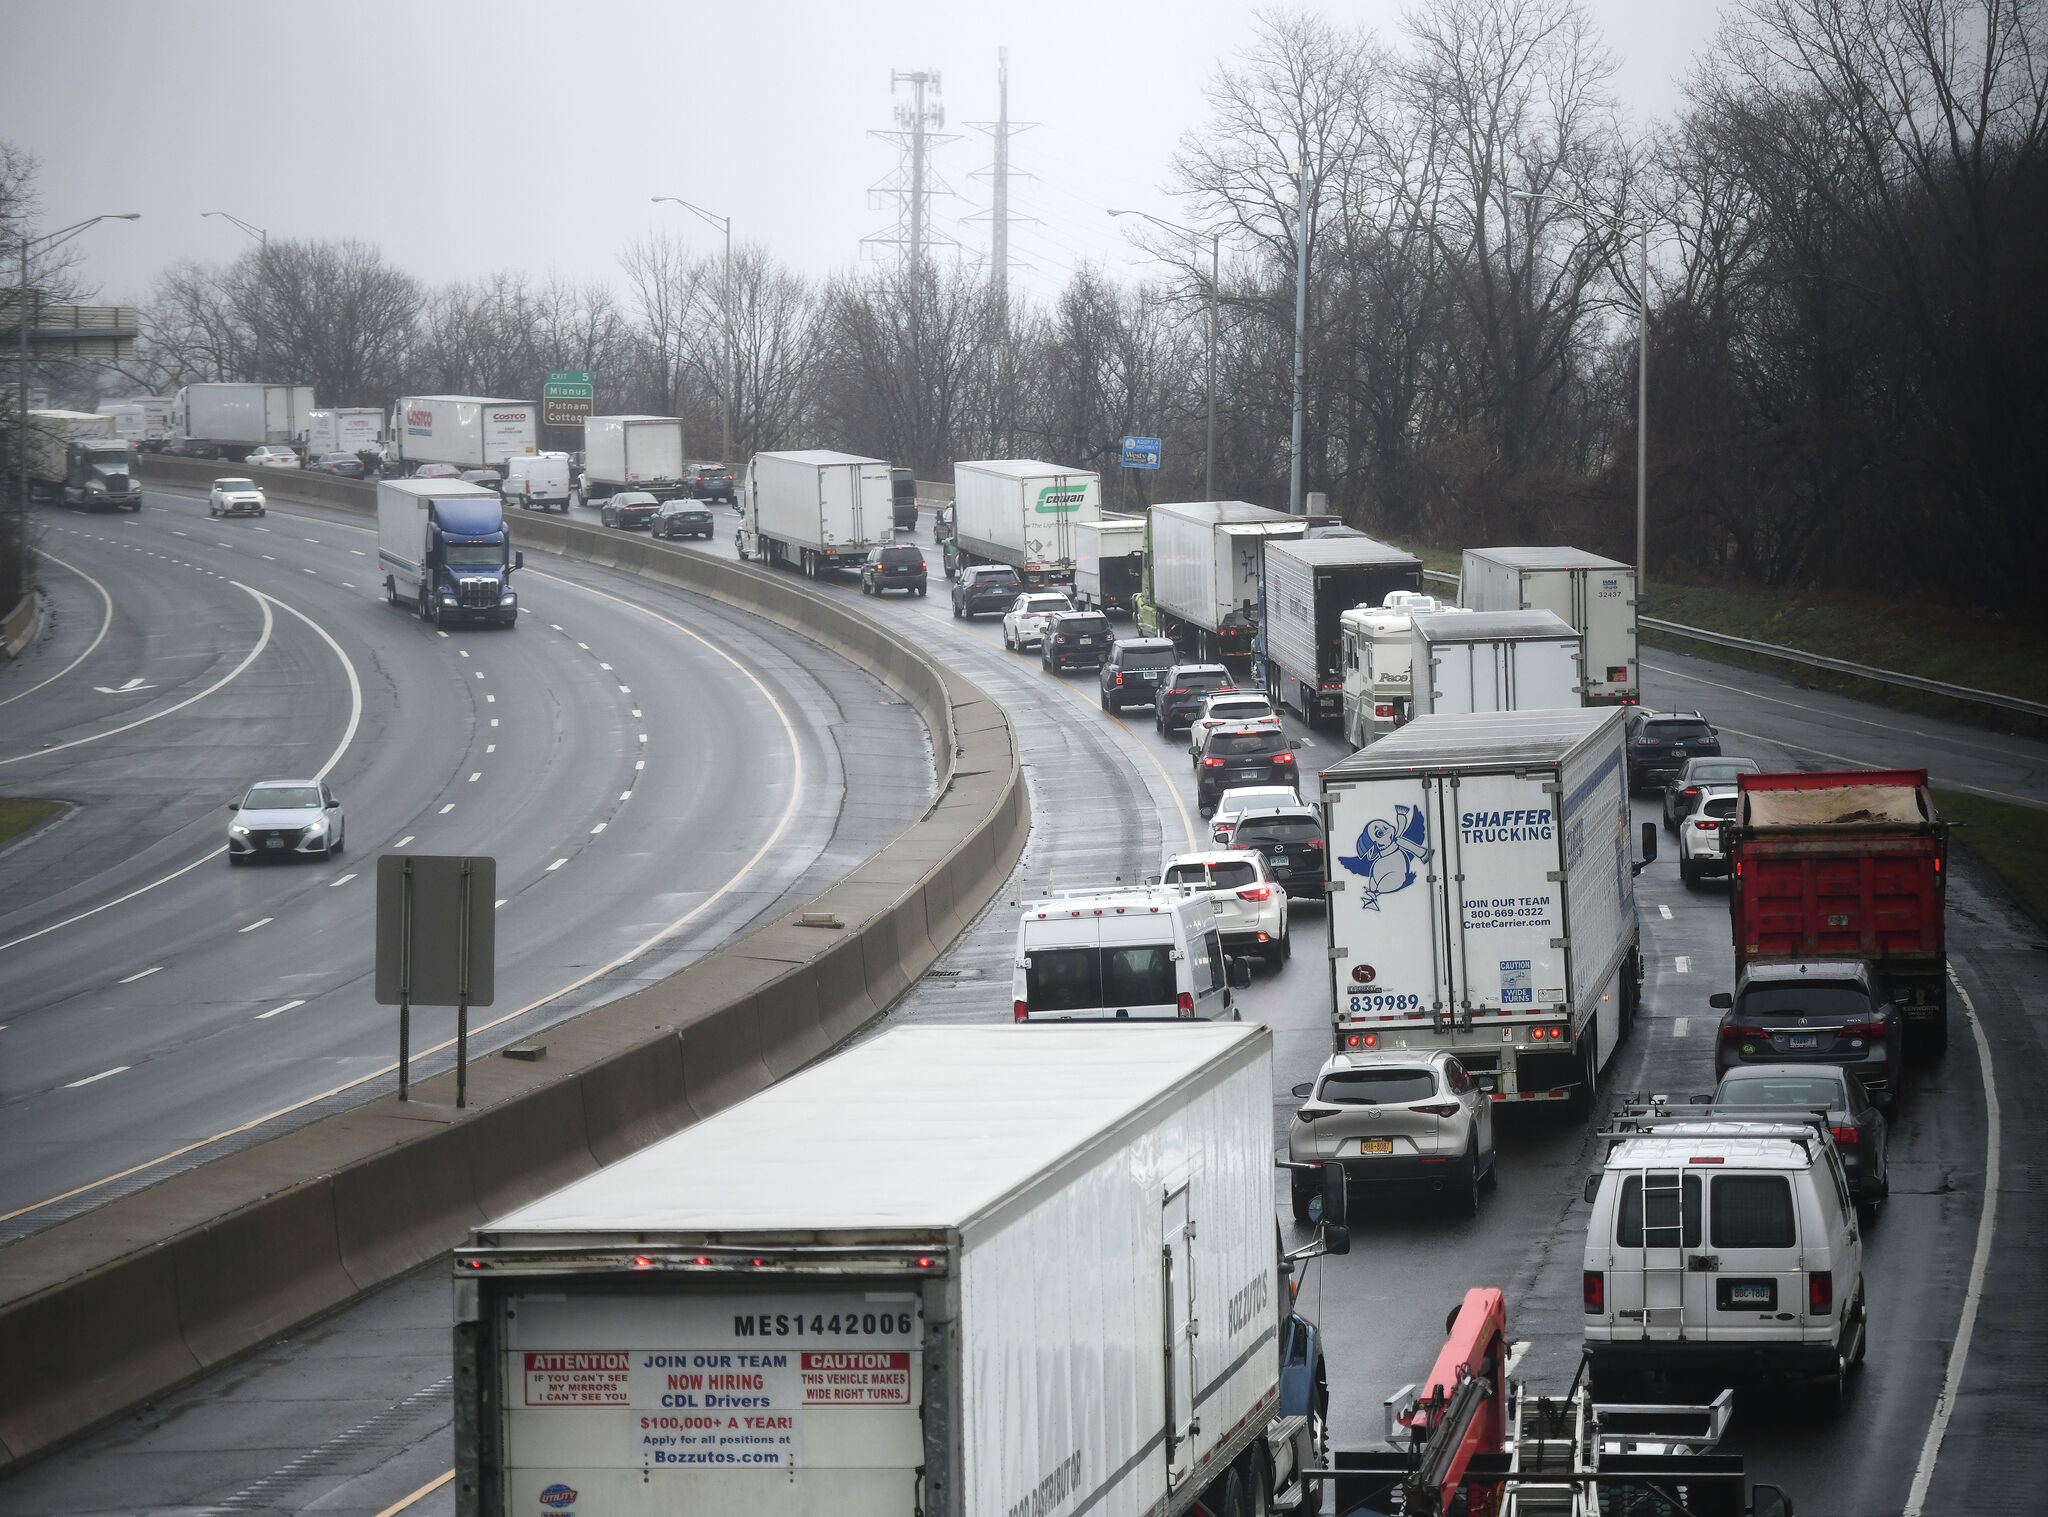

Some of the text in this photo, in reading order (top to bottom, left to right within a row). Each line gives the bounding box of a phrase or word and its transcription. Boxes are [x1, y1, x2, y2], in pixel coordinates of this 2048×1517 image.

[582, 373, 589, 381] 5
[550, 387, 587, 395] Mianus
[548, 402, 589, 410] Putnam
[548, 413, 586, 423] Cottag
[1379, 672, 1408, 682] Pace
[1461, 809, 1551, 828] SHAFFER
[1461, 826, 1552, 843] TRUCKING
[1463, 897, 1550, 908] JOIN OUR TEAM
[1471, 908, 1544, 918] 800-669-0322
[1463, 919, 1551, 929] CreteCarrier.com
[1500, 961, 1530, 970] CAUTION
[1350, 994, 1419, 1012] 839989
[735, 1313, 912, 1336] MES1442006
[534, 1354, 629, 1369] ATTENTION
[644, 1356, 787, 1368] JOIN OUR TEAM
[810, 1354, 891, 1369] CAUTION
[573, 1374, 604, 1382] CAN'T
[668, 1374, 764, 1390] NOW HIRING
[802, 1374, 906, 1384] THIS VEHICLE MAKES
[547, 1393, 578, 1401] CAN'T
[806, 1389, 903, 1399] WIDE RIGHT TURNS.
[661, 1394, 770, 1407] CDL Drivers
[640, 1417, 793, 1431] $100,000+ A YEAR!
[643, 1435, 791, 1446] Apply for all positions at
[655, 1451, 779, 1463] Bozzutos.com
[542, 1491, 577, 1503] UTILITY
